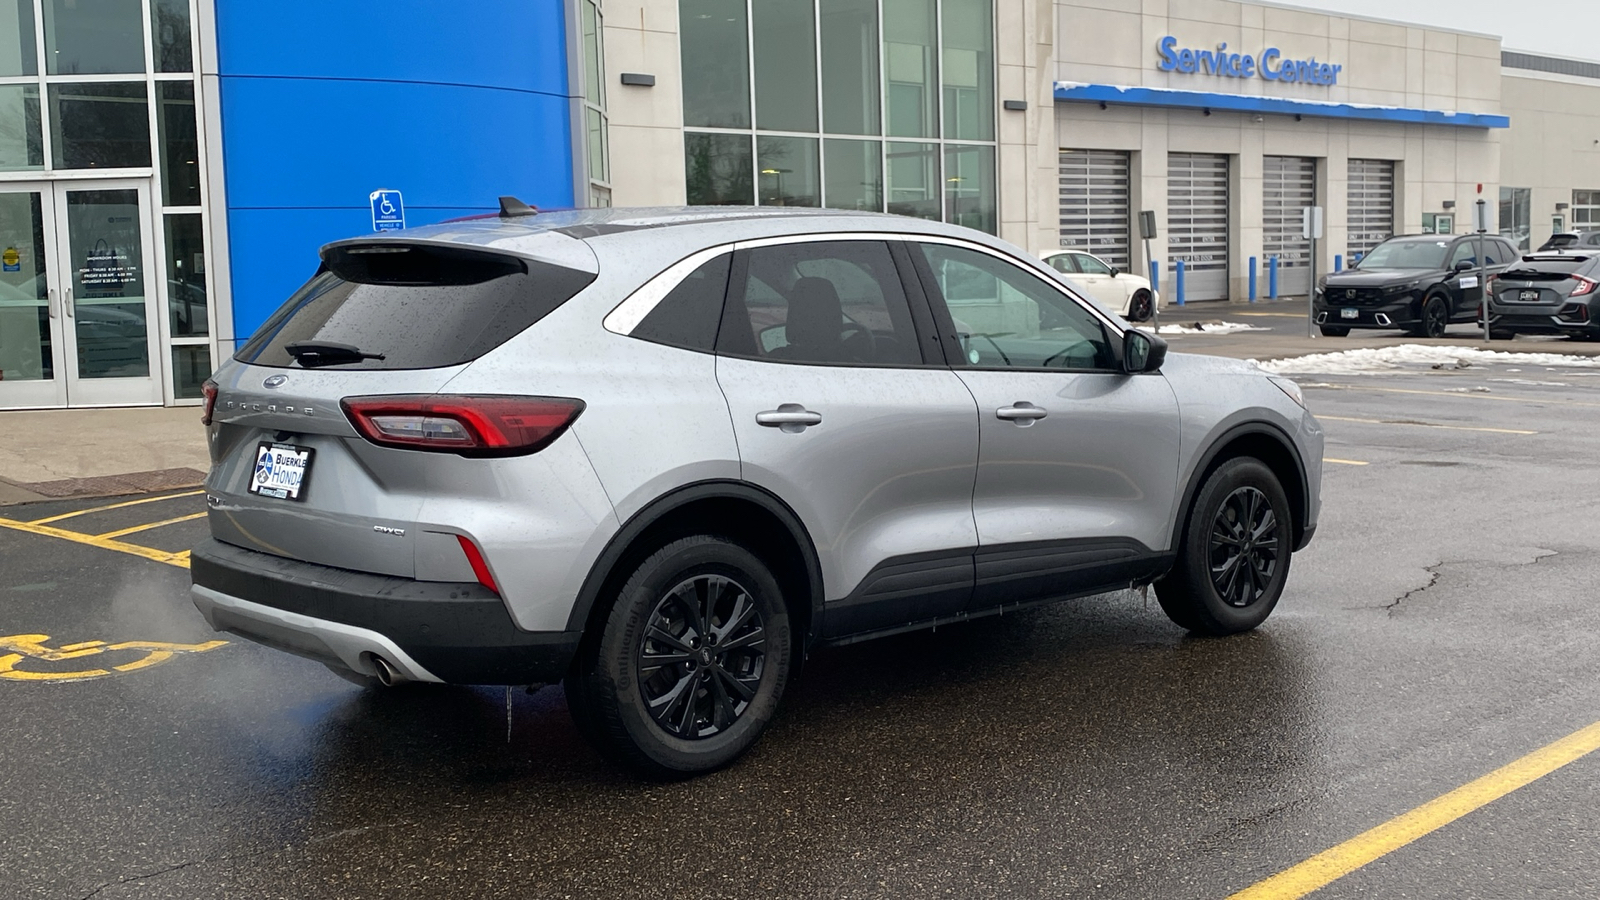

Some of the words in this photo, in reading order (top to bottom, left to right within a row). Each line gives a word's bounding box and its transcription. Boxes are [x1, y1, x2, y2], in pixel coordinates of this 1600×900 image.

[1156, 35, 1255, 79] Service
[1258, 46, 1342, 86] Center
[272, 466, 303, 486] HONDA
